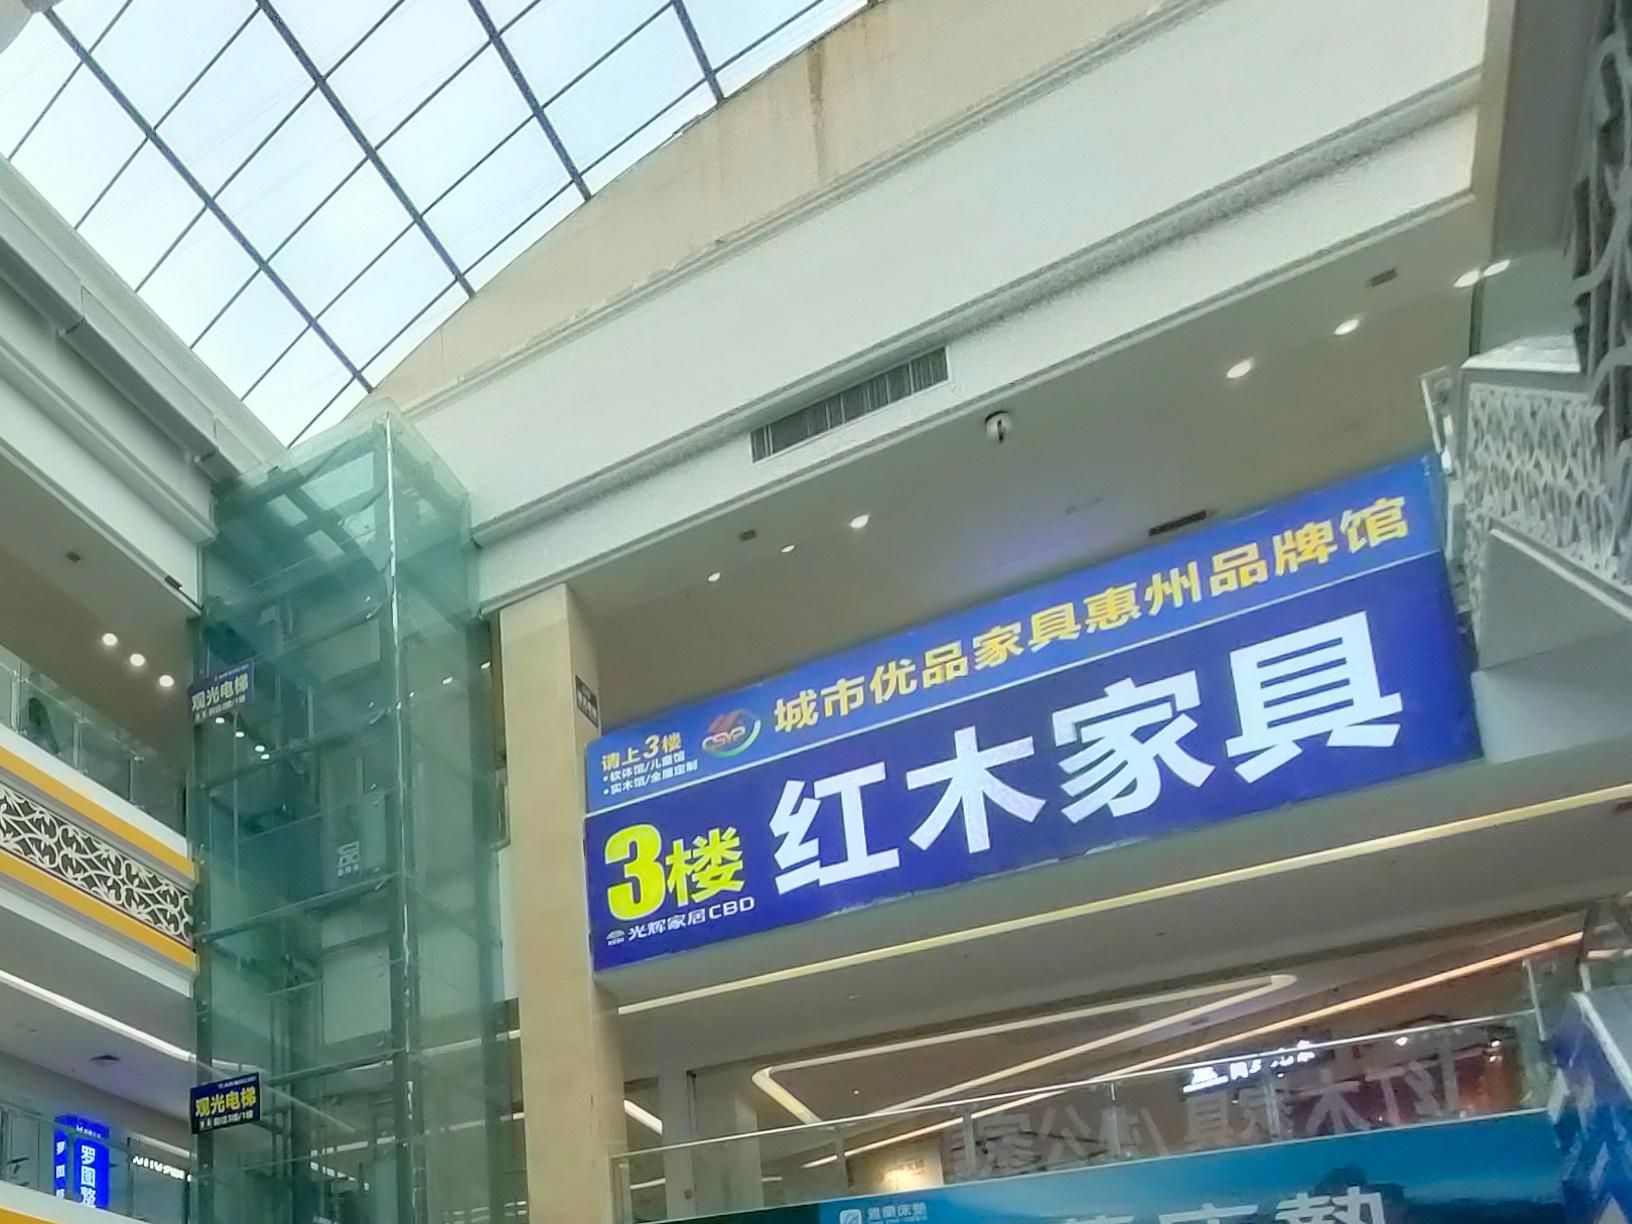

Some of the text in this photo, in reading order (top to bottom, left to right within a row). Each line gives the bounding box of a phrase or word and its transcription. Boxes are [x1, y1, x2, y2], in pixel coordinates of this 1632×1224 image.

[773, 496, 1409, 735] 城市优品家具惠州品牌馆
[602, 732, 682, 771] 请上3楼
[769, 611, 1404, 897] 红木家具
[604, 823, 746, 921] 3楼
[628, 896, 756, 942] 光辉家居CBD
[195, 1086, 257, 1118] 观光电梯
